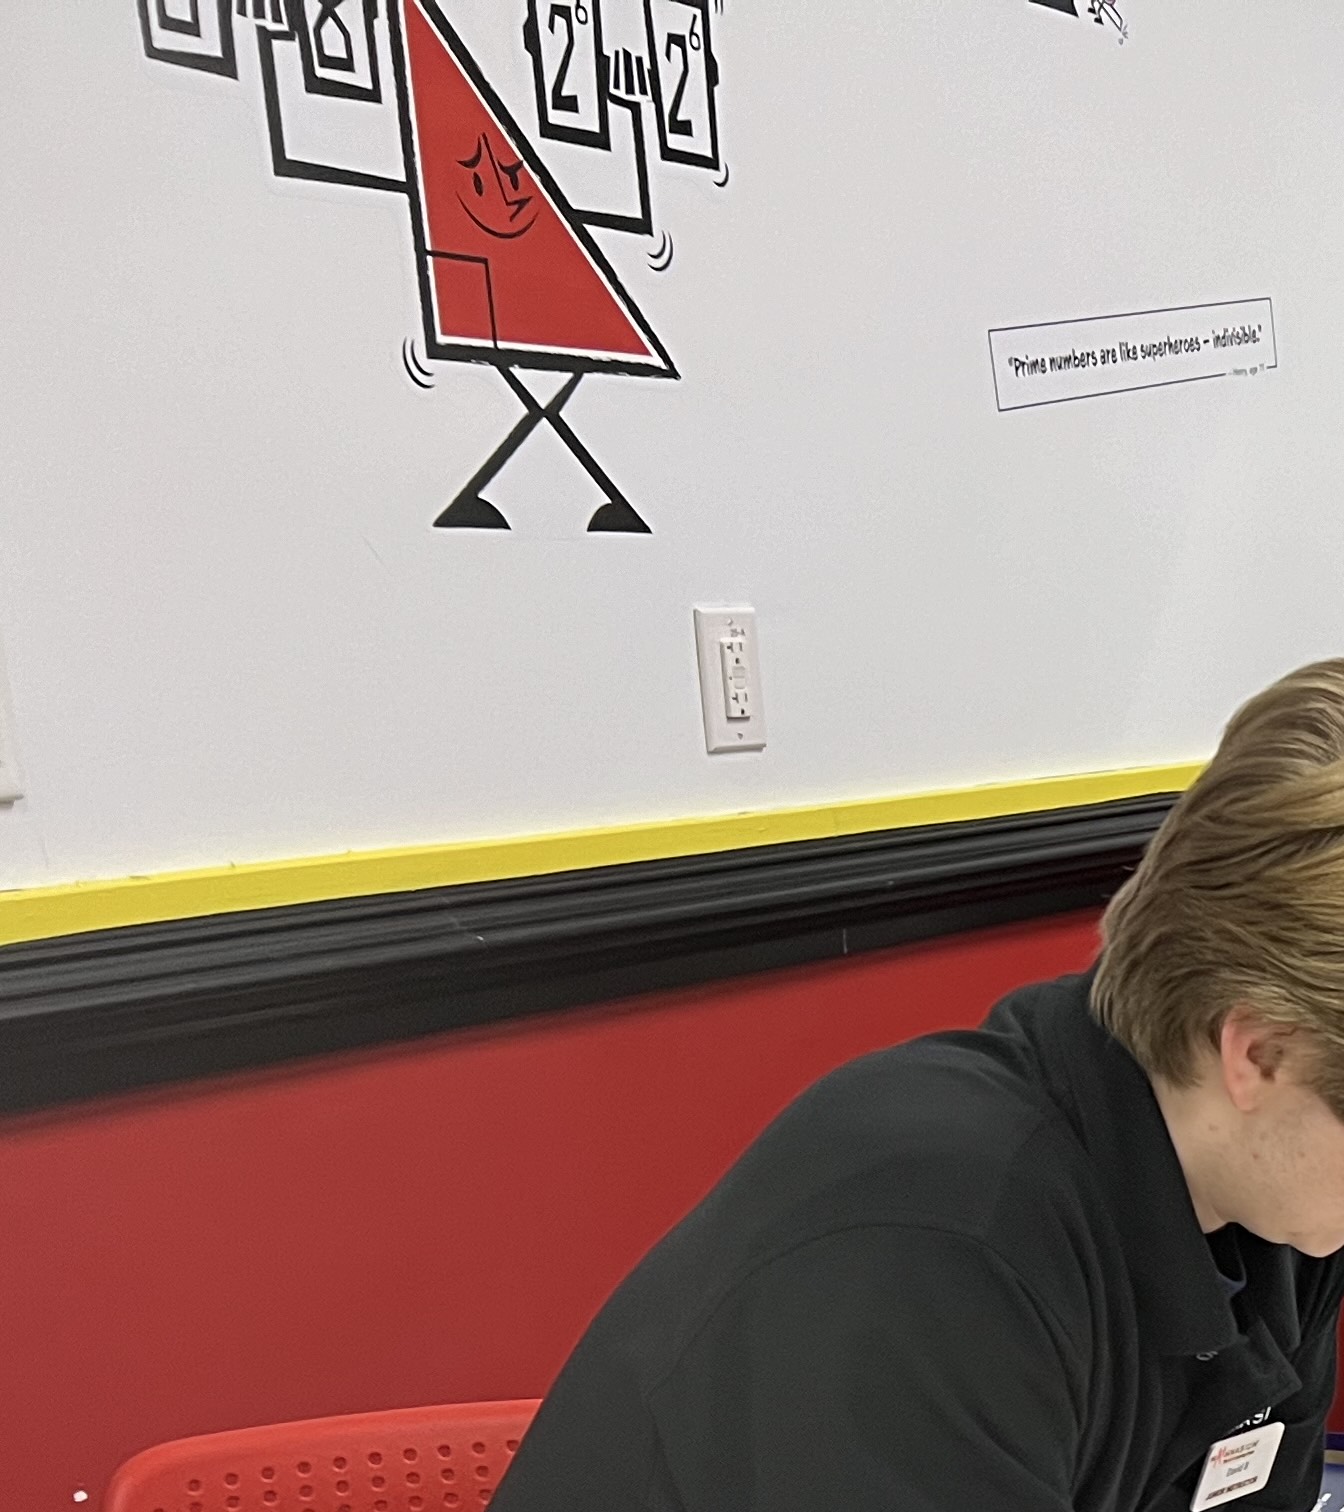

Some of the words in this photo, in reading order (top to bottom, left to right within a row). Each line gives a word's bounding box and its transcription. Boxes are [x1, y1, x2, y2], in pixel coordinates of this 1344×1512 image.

[1049, 348, 1098, 371] numbers
[1100, 346, 1117, 364] are
[1119, 341, 1138, 362] like
[1140, 335, 1201, 362] superheroes
